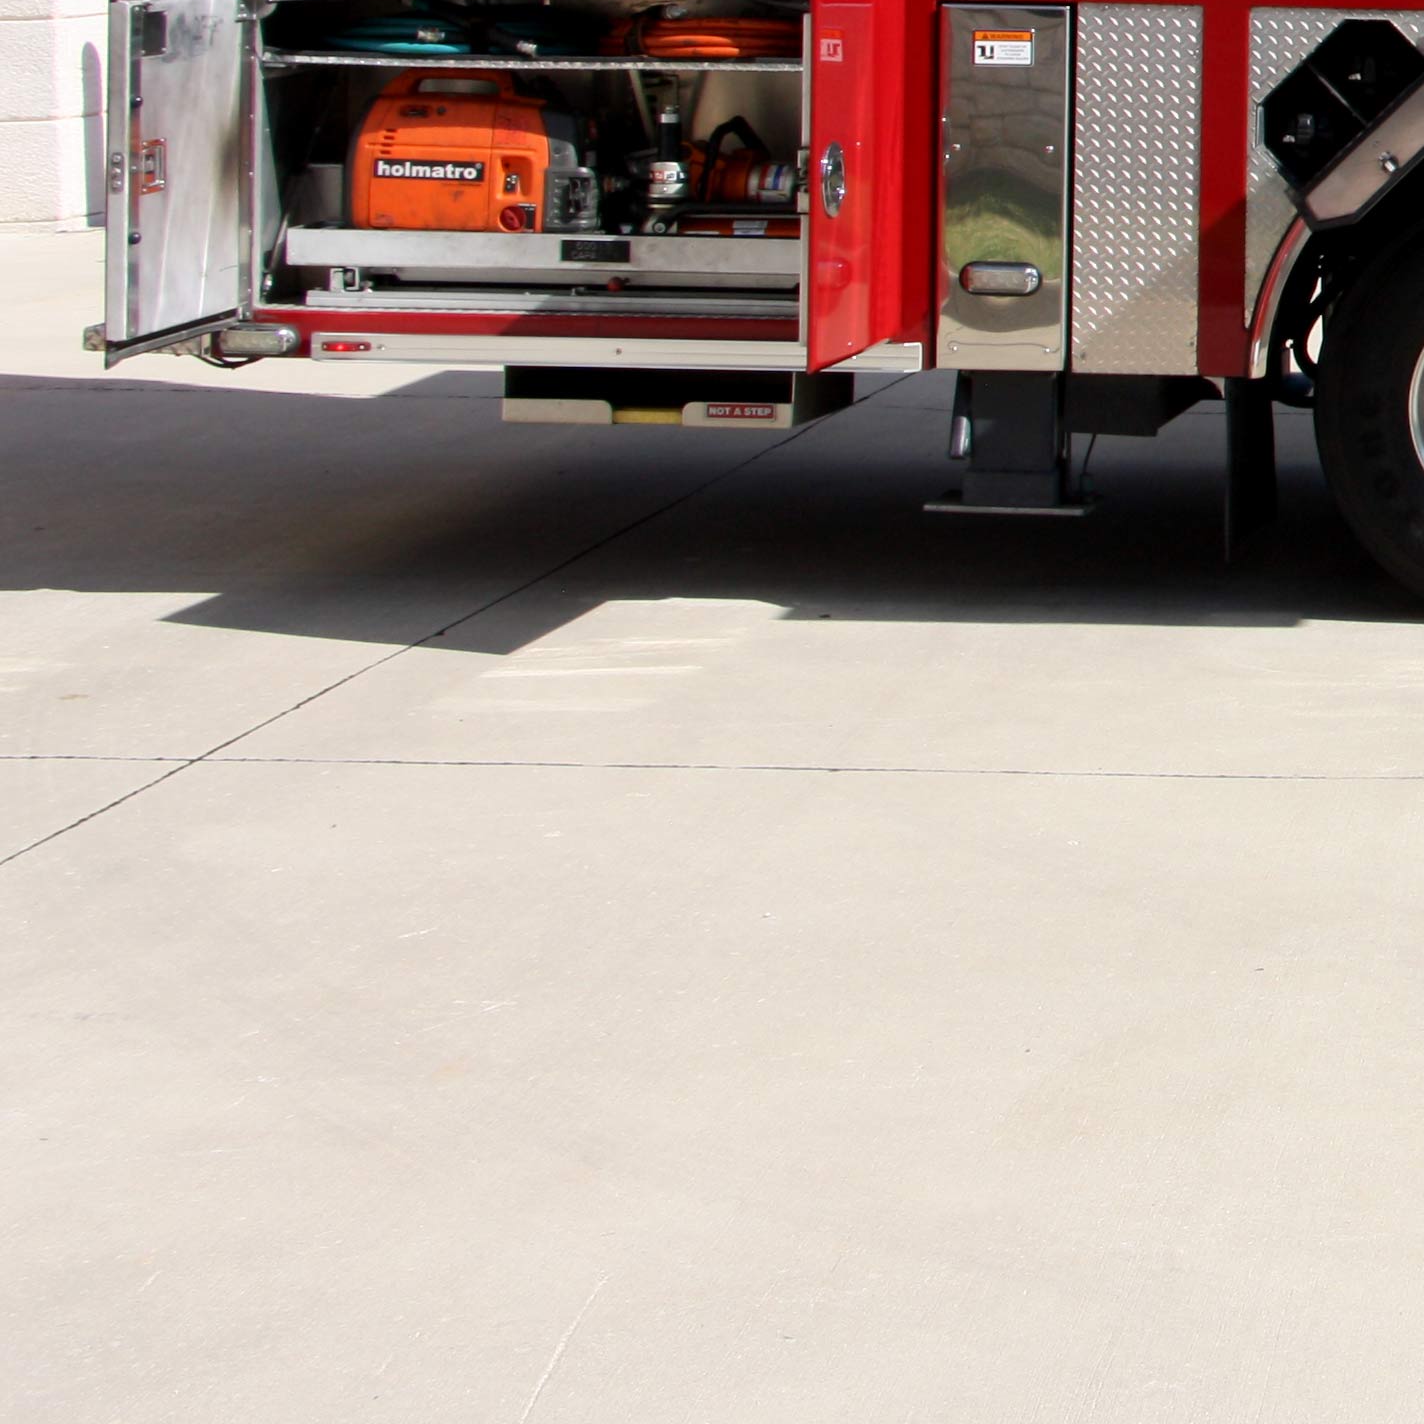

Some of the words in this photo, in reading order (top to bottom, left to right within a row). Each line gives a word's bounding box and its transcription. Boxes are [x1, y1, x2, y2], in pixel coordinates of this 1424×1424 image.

[376, 160, 478, 180] holmatro
[708, 407, 731, 416] NOT
[733, 407, 742, 416] A
[744, 408, 772, 416] STEP
